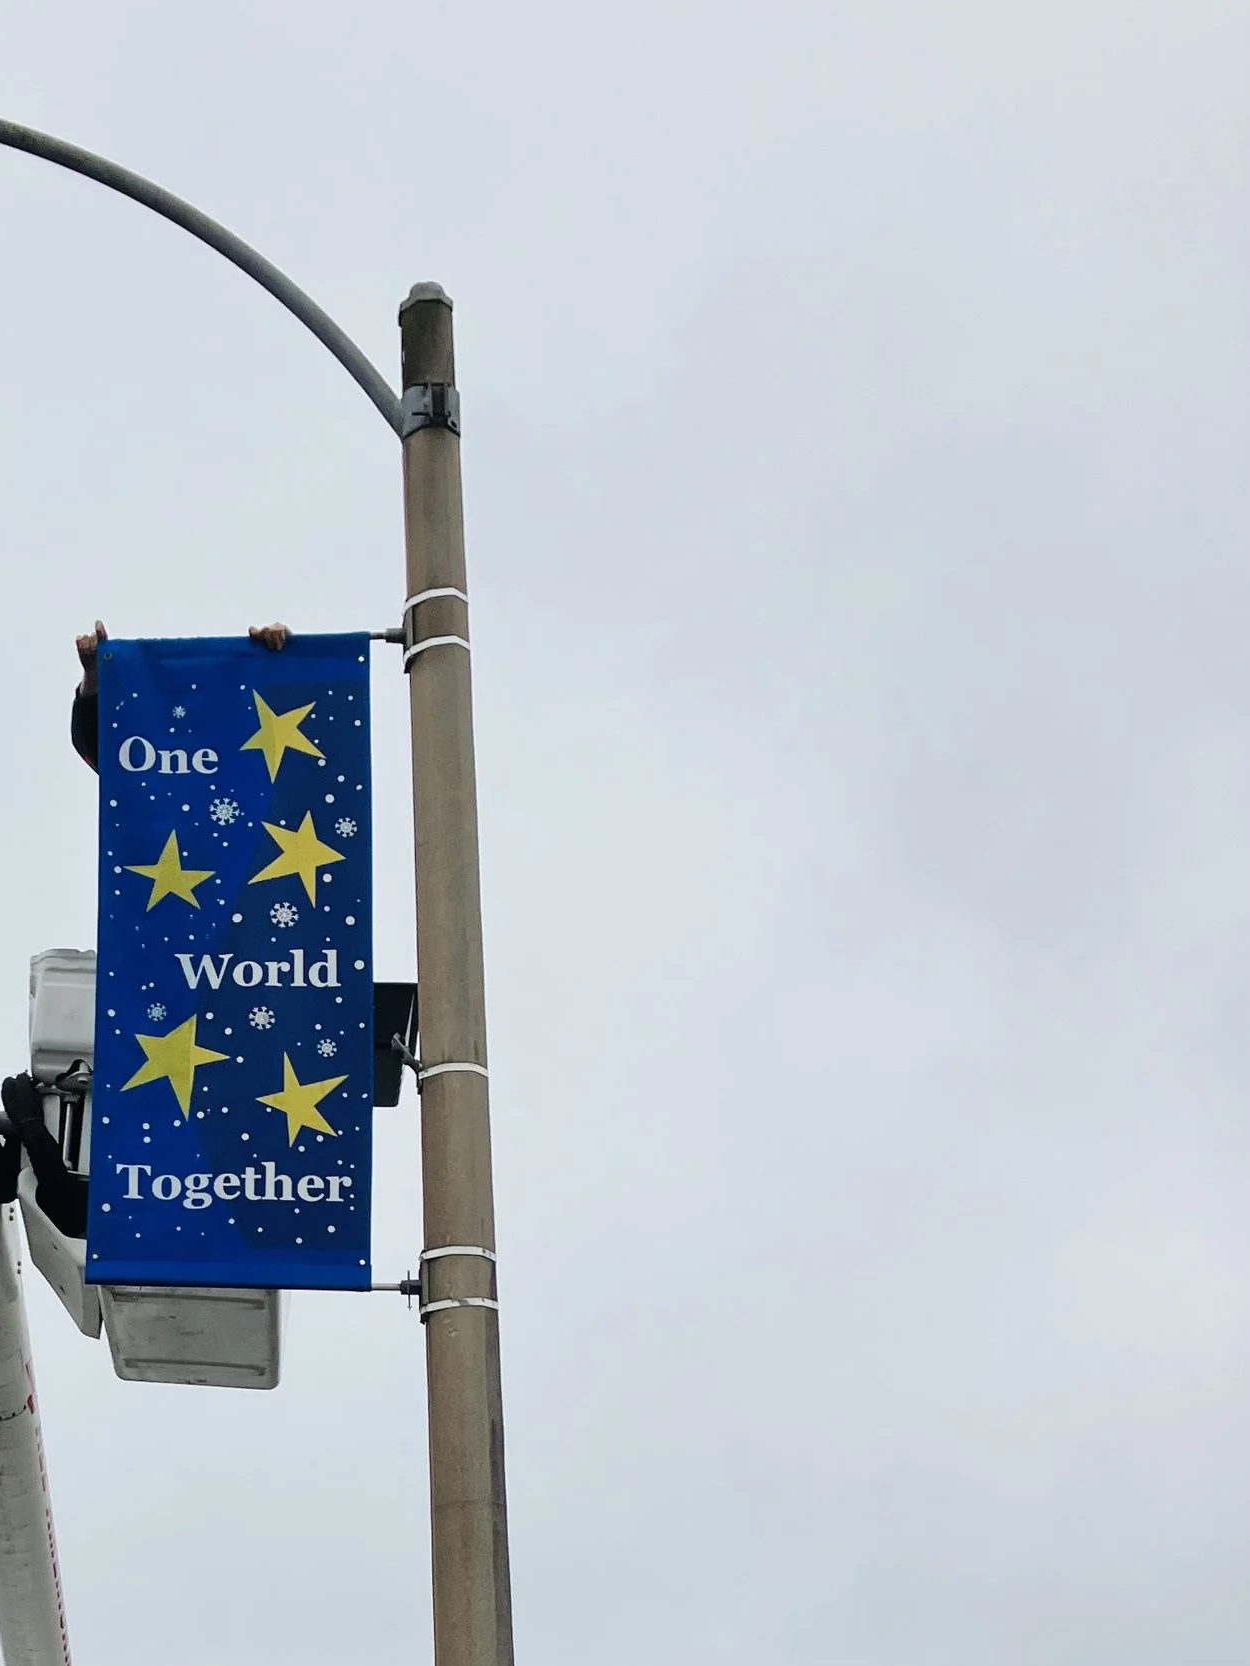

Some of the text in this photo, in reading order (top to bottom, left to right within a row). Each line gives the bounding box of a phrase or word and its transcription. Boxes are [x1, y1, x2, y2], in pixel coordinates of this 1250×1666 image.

[119, 735, 218, 774] One
[174, 948, 341, 989] World
[116, 1161, 352, 1209] Together
